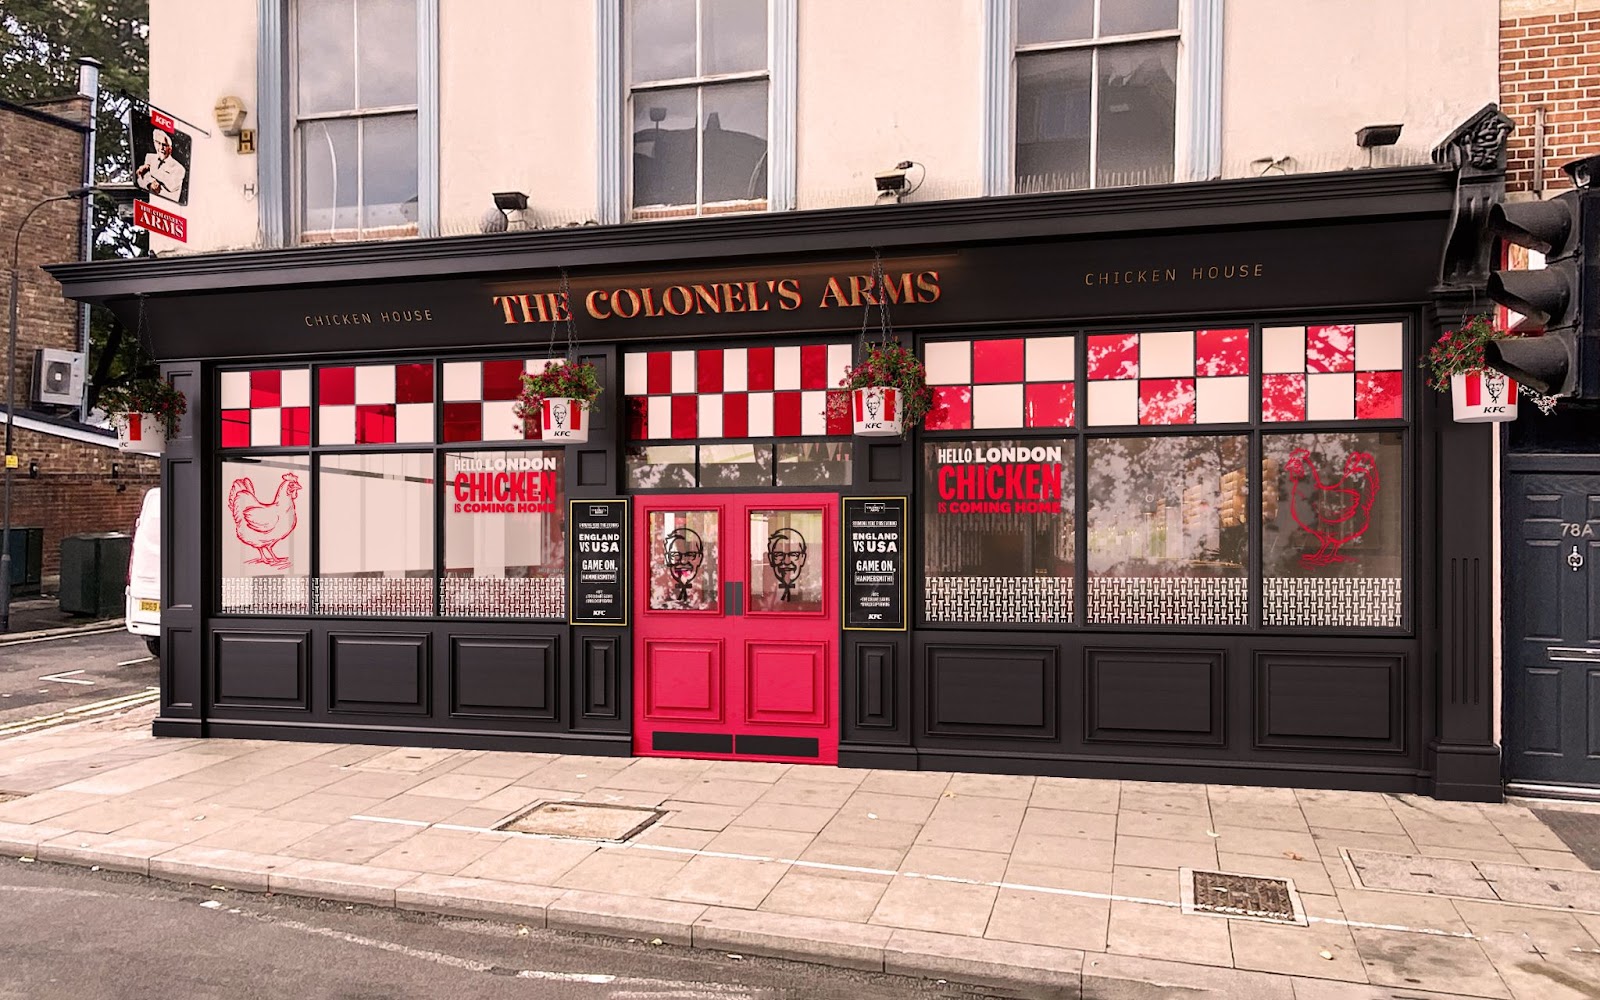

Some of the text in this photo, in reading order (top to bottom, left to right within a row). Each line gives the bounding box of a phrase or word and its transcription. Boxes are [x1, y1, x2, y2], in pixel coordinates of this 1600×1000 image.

[155, 115, 172, 129] KFC
[140, 211, 184, 238] ARMS
[1085, 264, 1263, 286] CHICKEN HOUSE
[493, 271, 942, 324] THE COLONEL'S ARMS
[304, 309, 433, 327] CHICKEN HOUSE
[938, 446, 1062, 464] HELLO LONDON
[454, 457, 557, 471] HELLO LONDON
[454, 471, 557, 502] CHICKEN
[938, 463, 1062, 500] CHICKEN
[454, 503, 557, 513] IS COMING HOME
[938, 501, 1062, 514] IS COMING HOME
[579, 533, 620, 541] ENGLAND
[852, 532, 898, 540] ENGLAND
[1560, 523, 1595, 537] 78A
[579, 541, 620, 553] VS USA
[853, 541, 898, 553] VS USA
[582, 560, 603, 570] GAME
[856, 560, 897, 573] GAME ON,
